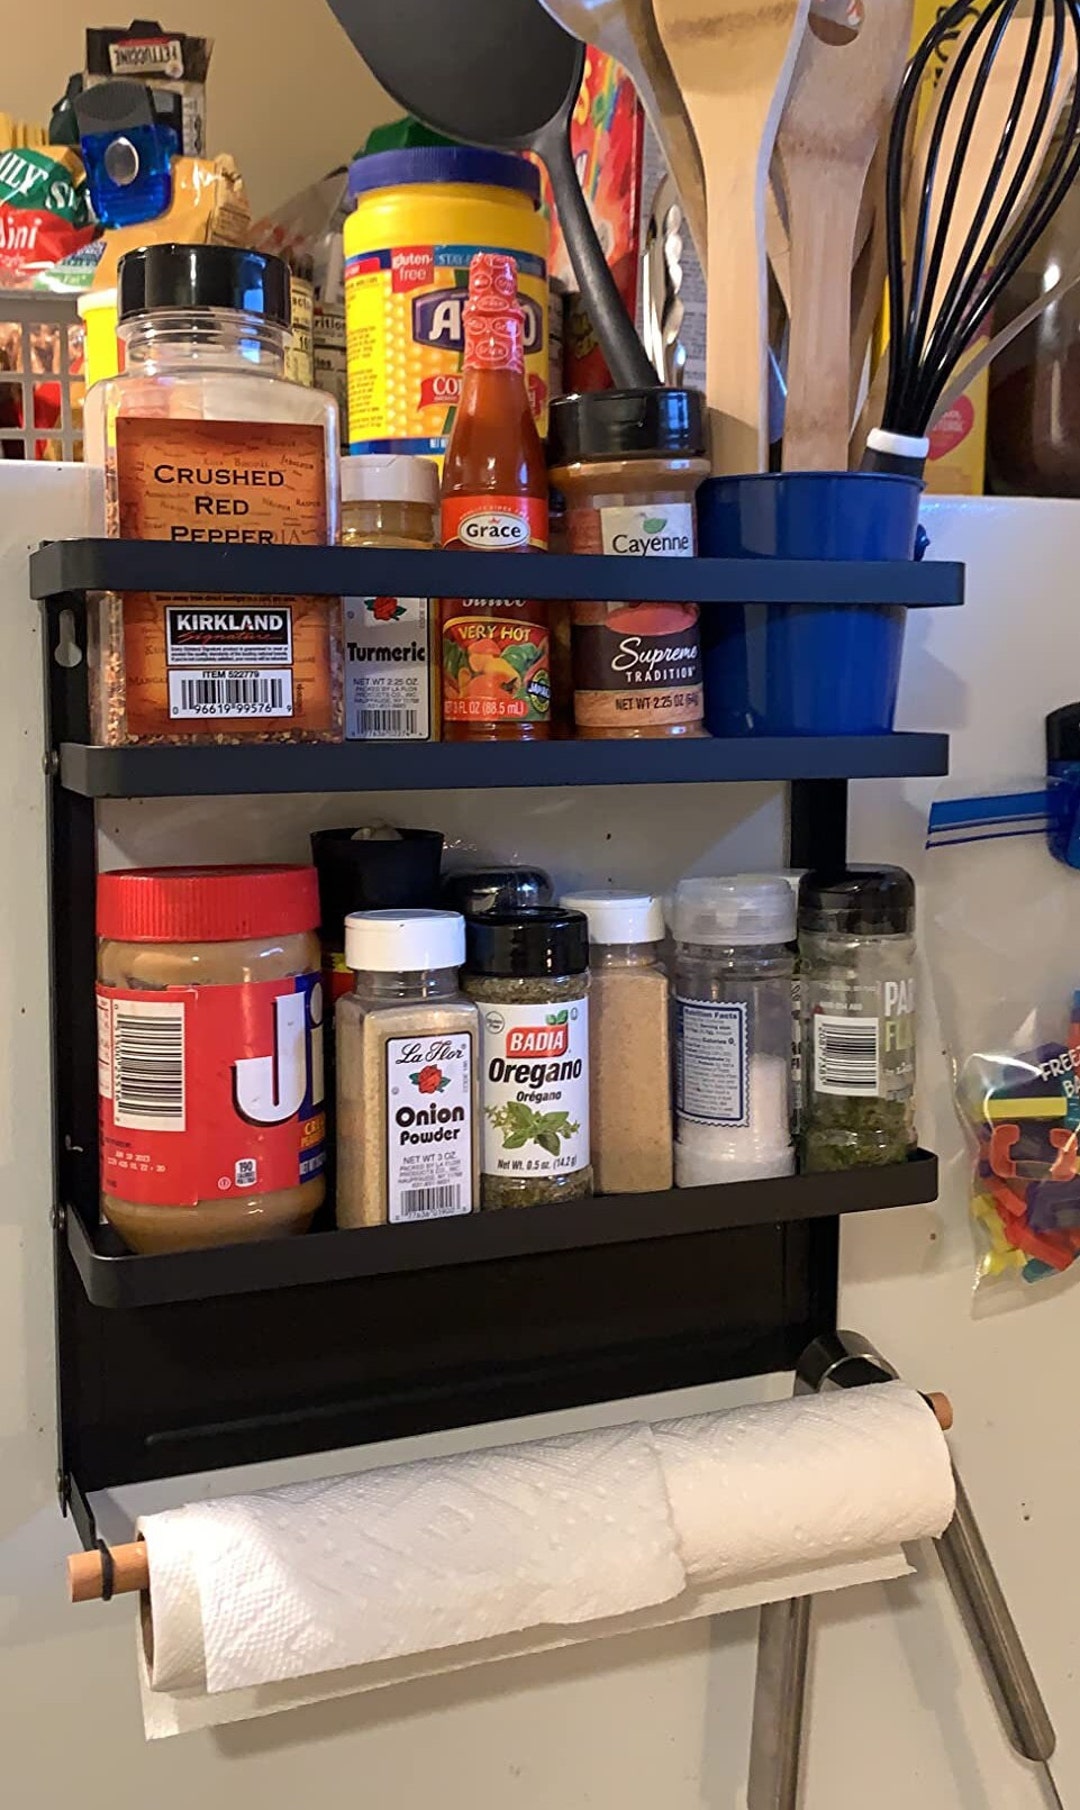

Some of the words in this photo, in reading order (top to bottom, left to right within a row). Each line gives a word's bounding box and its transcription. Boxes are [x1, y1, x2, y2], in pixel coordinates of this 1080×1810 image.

[0, 217, 42, 250] ini
[399, 267, 427, 281] free
[154, 464, 285, 487] CRUSHED
[194, 495, 249, 515] RED
[170, 525, 274, 545] PEPPER
[466, 523, 521, 538] Grace
[612, 533, 690, 557] Cayenne
[177, 614, 283, 631] KIRKLAND
[177, 631, 283, 646] Signature
[458, 625, 497, 640] VERY
[501, 626, 531, 642] HOT
[347, 641, 426, 662] Turmeric
[611, 636, 698, 671] Supreme
[202, 670, 226, 679] ITEM
[228, 670, 260, 679] 522779
[371, 678, 385, 686] WT
[626, 667, 694, 682] TRADITION
[195, 704, 231, 714] 96619
[236, 703, 272, 714] 99576
[469, 702, 480, 714] OZ
[615, 698, 634, 711] NET
[636, 697, 651, 710] WT
[884, 979, 914, 1016] PA
[510, 1031, 564, 1052] BADIA
[233, 981, 326, 1126] Ji
[395, 1043, 424, 1064] La
[425, 1040, 464, 1062] Flor
[488, 1057, 582, 1089] Oregano
[1039, 1045, 1080, 1081] FREE
[516, 1091, 562, 1104] Orégano
[395, 1102, 465, 1128] Onion
[400, 1126, 460, 1146] Powder
[403, 1155, 420, 1164] NET
[422, 1153, 436, 1163] WT
[497, 1159, 510, 1170] Net
[512, 1159, 524, 1170] Wt.
[526, 1160, 540, 1170] 0.5
